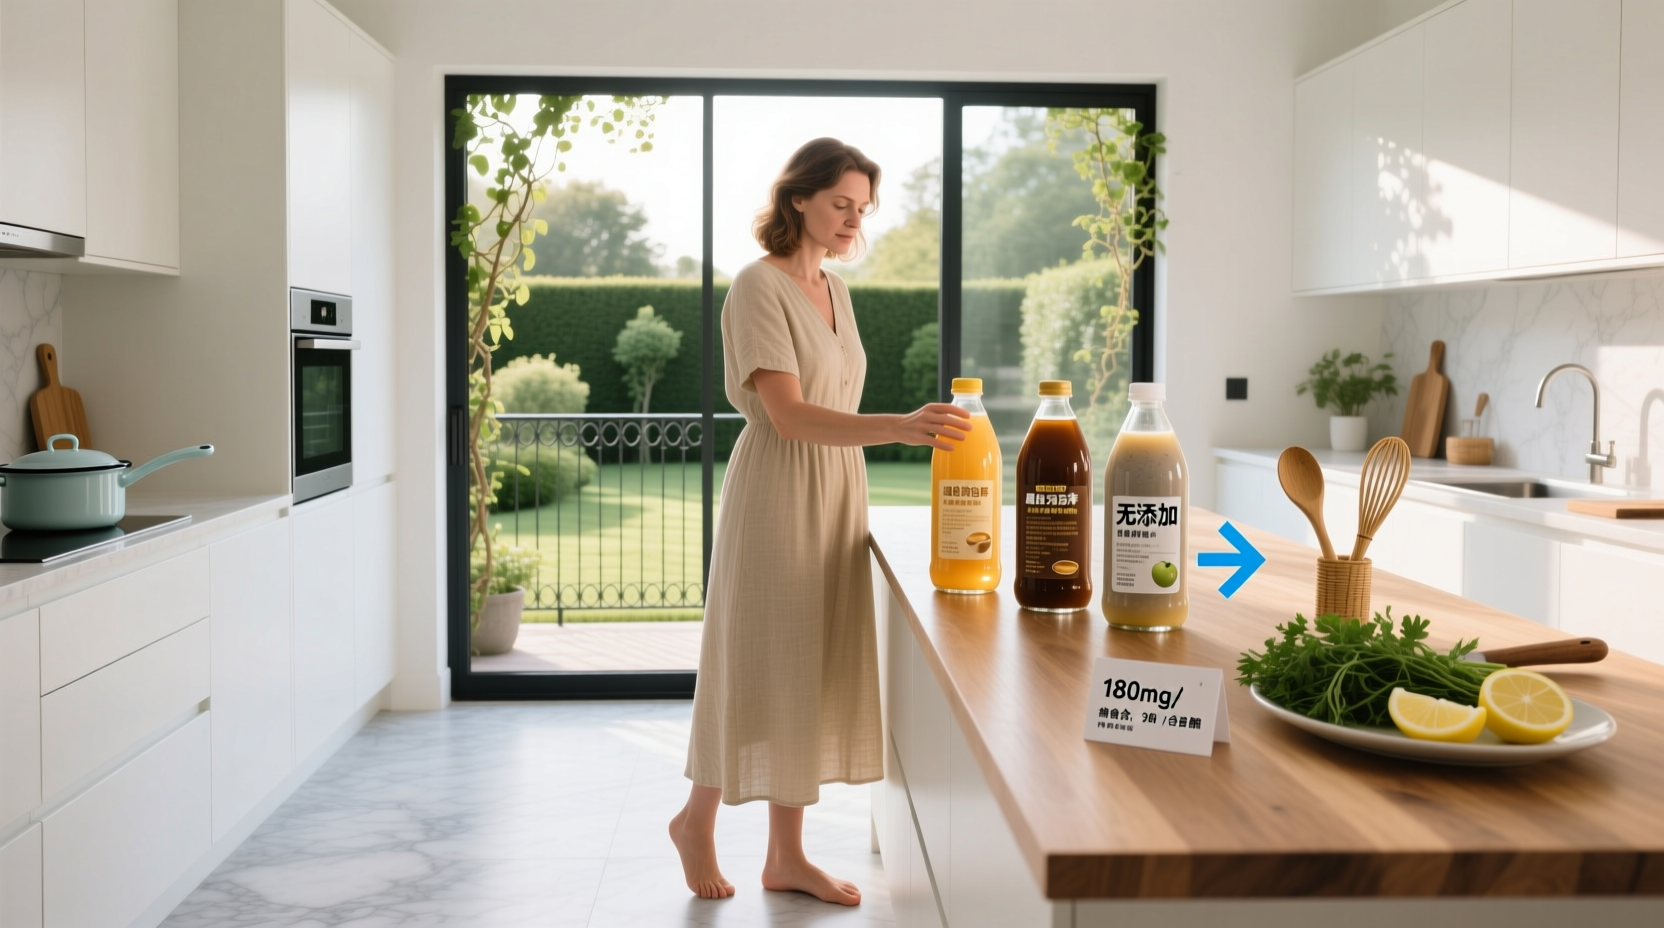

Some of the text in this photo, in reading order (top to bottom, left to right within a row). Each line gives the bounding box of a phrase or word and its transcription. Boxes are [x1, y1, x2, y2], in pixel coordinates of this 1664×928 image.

[1116, 503, 1178, 527] 无添加
[1103, 678, 1184, 710] 180mg/
